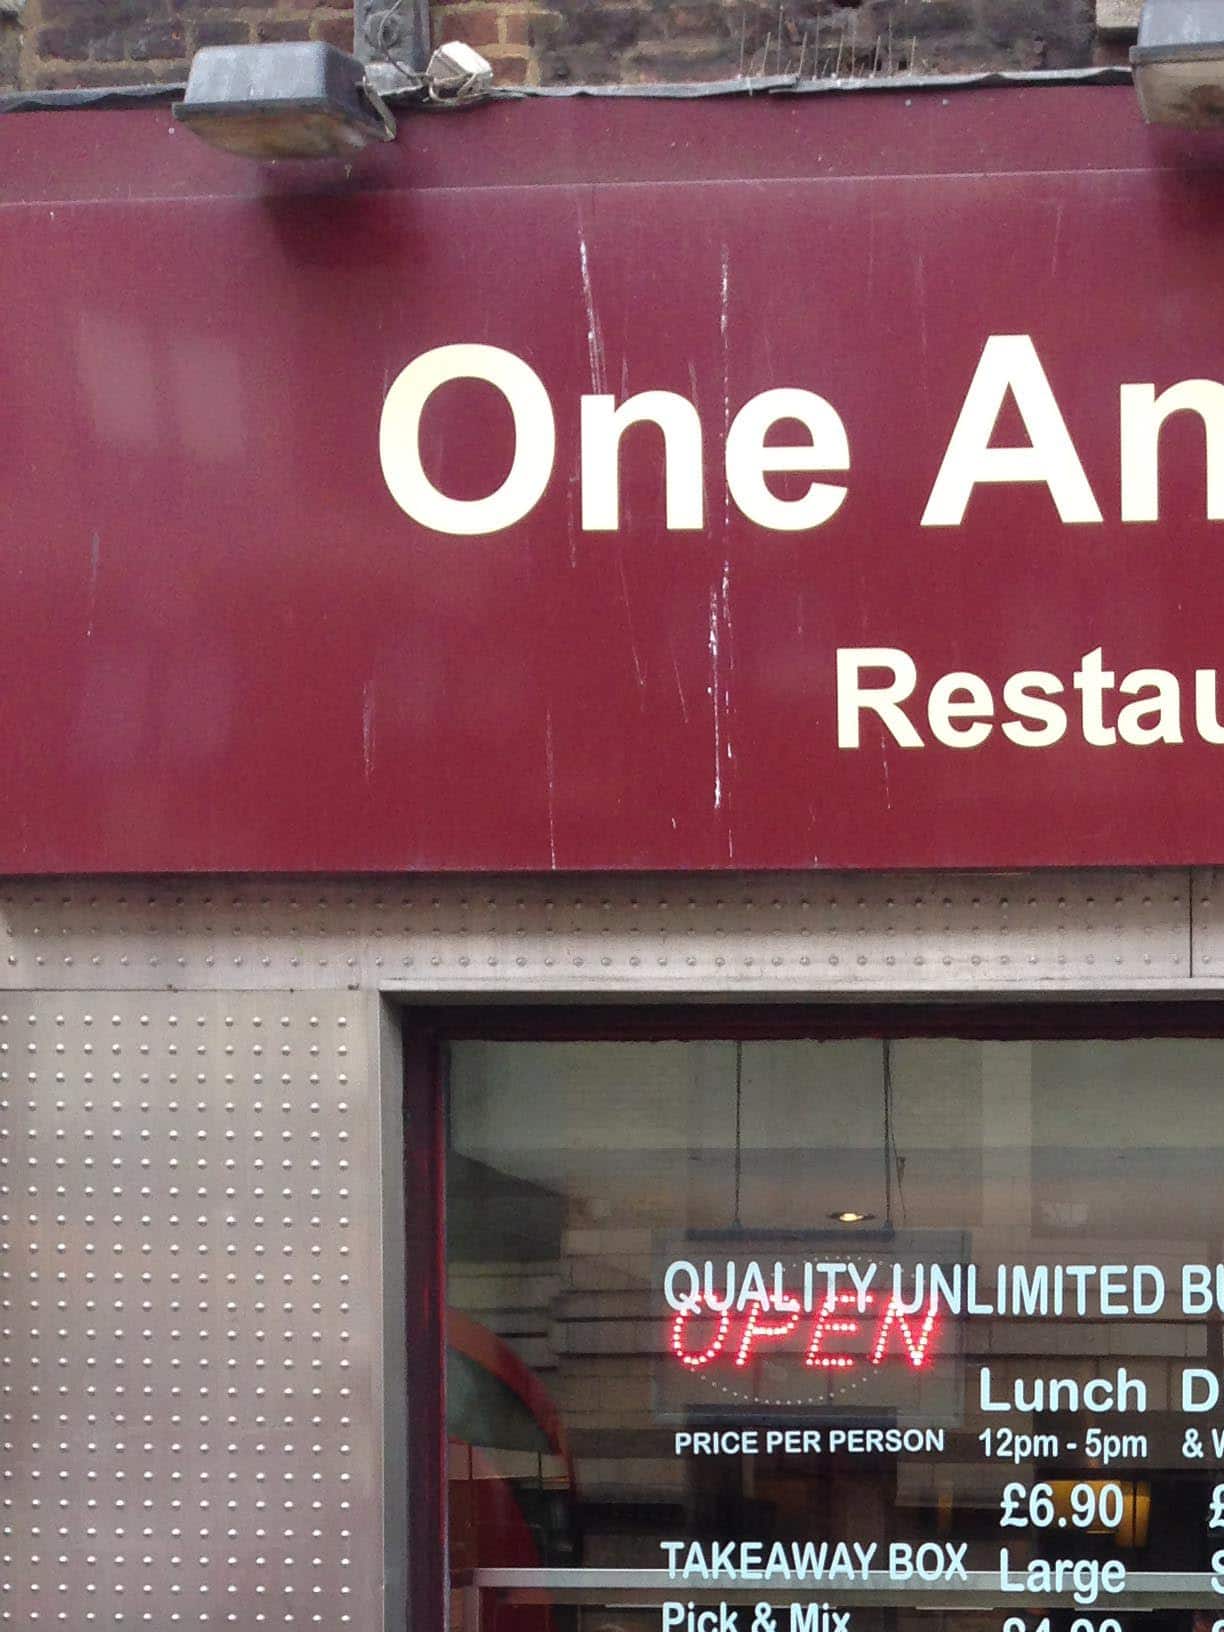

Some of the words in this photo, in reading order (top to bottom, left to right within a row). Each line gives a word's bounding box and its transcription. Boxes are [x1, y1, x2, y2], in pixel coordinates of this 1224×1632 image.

[378, 342, 853, 537] One
[663, 1259, 878, 1315] QUALITY
[891, 1262, 1166, 1316] UNLIMITED
[669, 1294, 940, 1366] OPEN
[979, 1366, 1148, 1413] Lunch
[674, 1430, 759, 1456] PRICE
[765, 1429, 821, 1454] PER
[828, 1427, 945, 1454] PERSON
[977, 1427, 1059, 1460] 12pm
[1065, 1442, 1077, 1450] -
[1084, 1427, 1148, 1463] 5pm
[1181, 1427, 1205, 1459] &
[998, 1481, 1125, 1529] £6.90
[659, 1541, 879, 1583] TAKEAWAY
[888, 1541, 968, 1582] BOX
[998, 1549, 1127, 1605] Large
